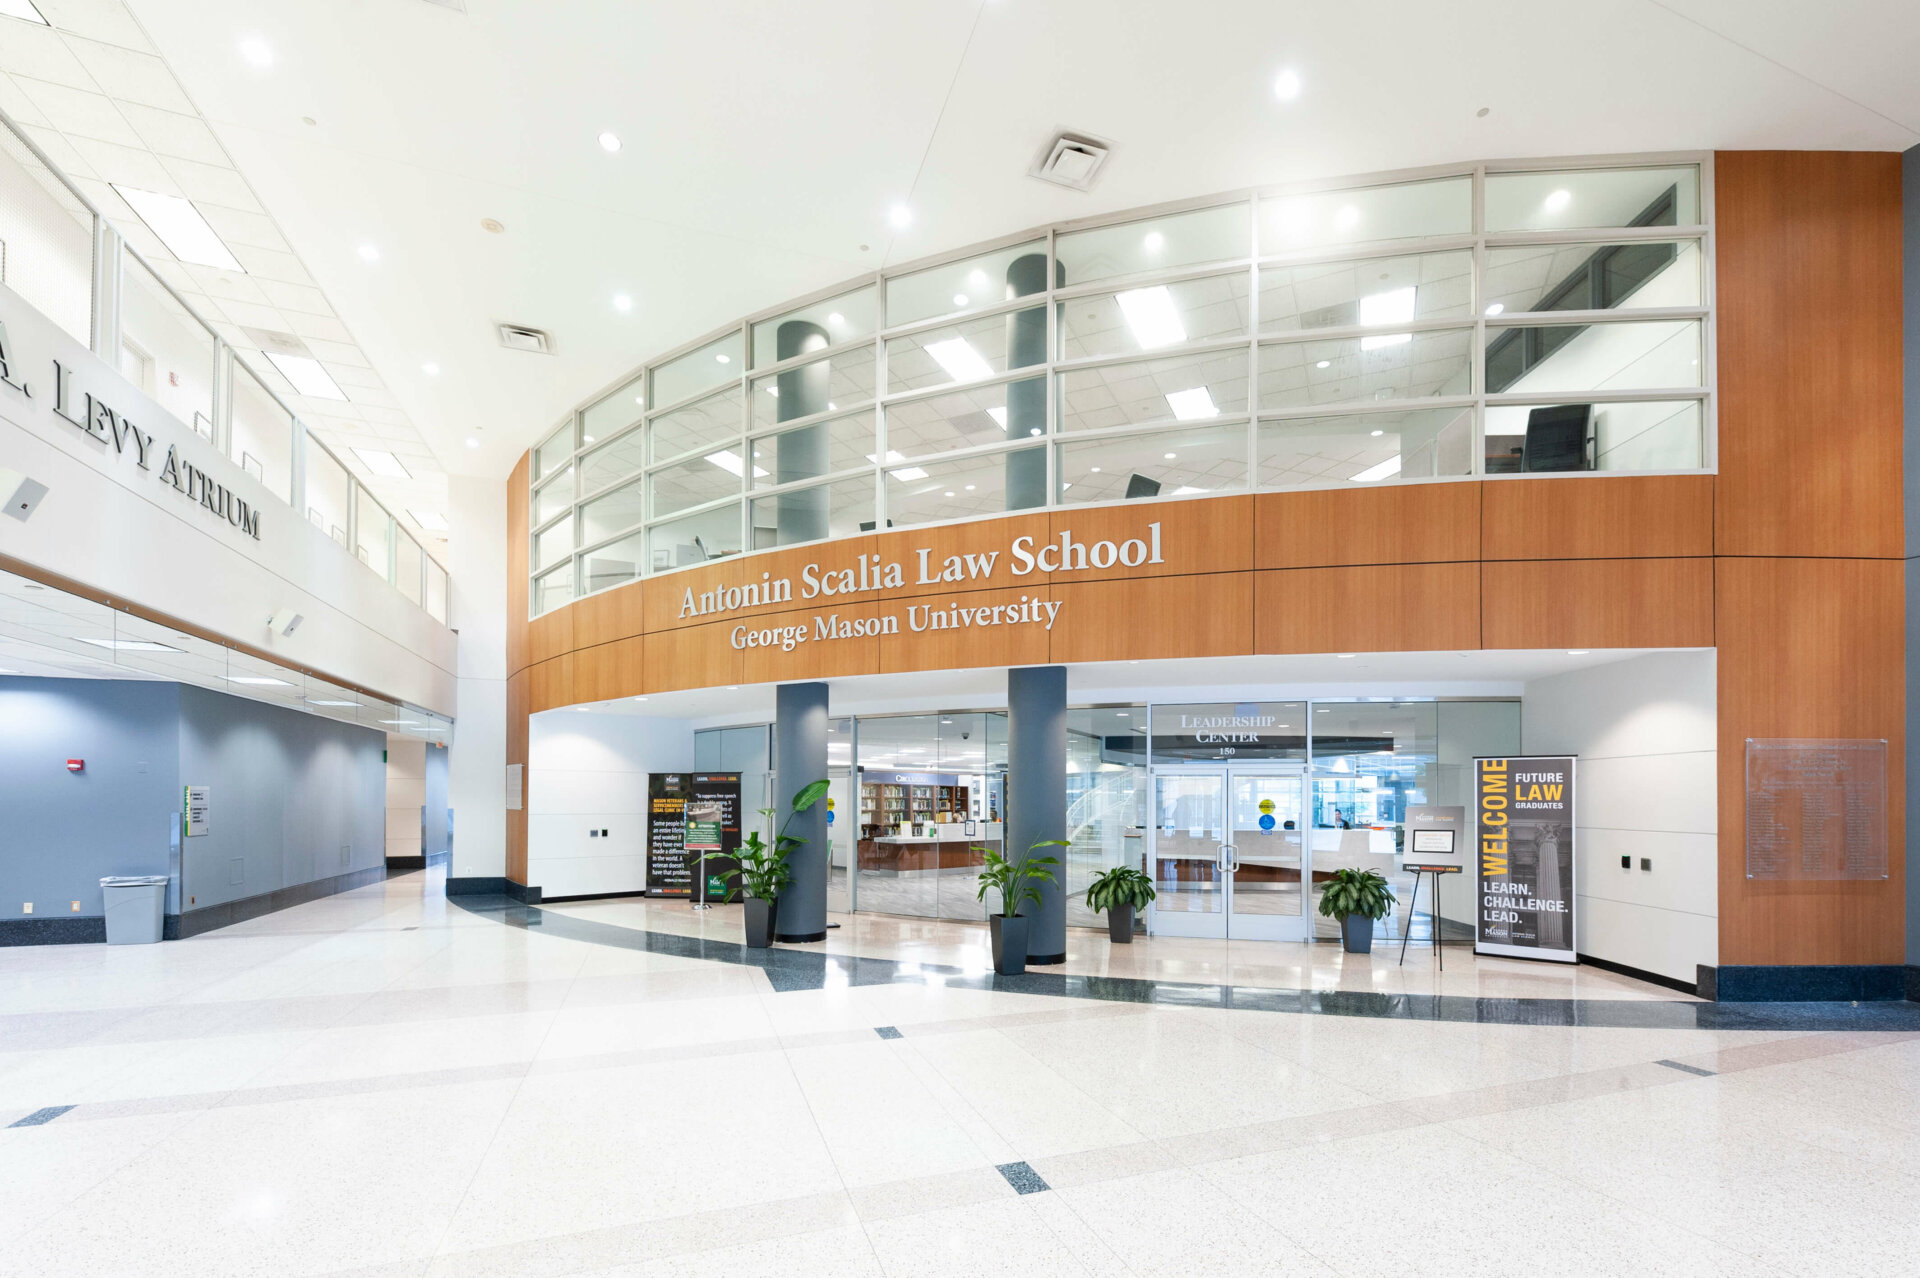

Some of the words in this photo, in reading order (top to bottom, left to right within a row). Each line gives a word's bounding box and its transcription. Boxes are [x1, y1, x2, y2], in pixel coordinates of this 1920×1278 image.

[53, 359, 156, 471] LEVY
[160, 444, 261, 541] ATRIUM
[678, 572, 793, 619] Antonin
[801, 553, 905, 599] Scalia
[915, 548, 1000, 585] Law
[1010, 521, 1165, 576] School
[731, 624, 808, 652] George
[813, 614, 899, 641] Mason
[907, 595, 1063, 632] University
[1181, 715, 1276, 728] LEADERSHIP
[1195, 729, 1259, 743] CENTER
[1219, 747, 1236, 755] 150
[1515, 772, 1564, 783] FUTURE
[1515, 784, 1564, 801] LAW
[1515, 802, 1564, 810] GRADUATES
[1482, 759, 1508, 876] WELCOME
[1483, 881, 1533, 896] LEARN.
[1483, 895, 1569, 913] CHALLENGE.
[1483, 909, 1523, 924] LEAD.
